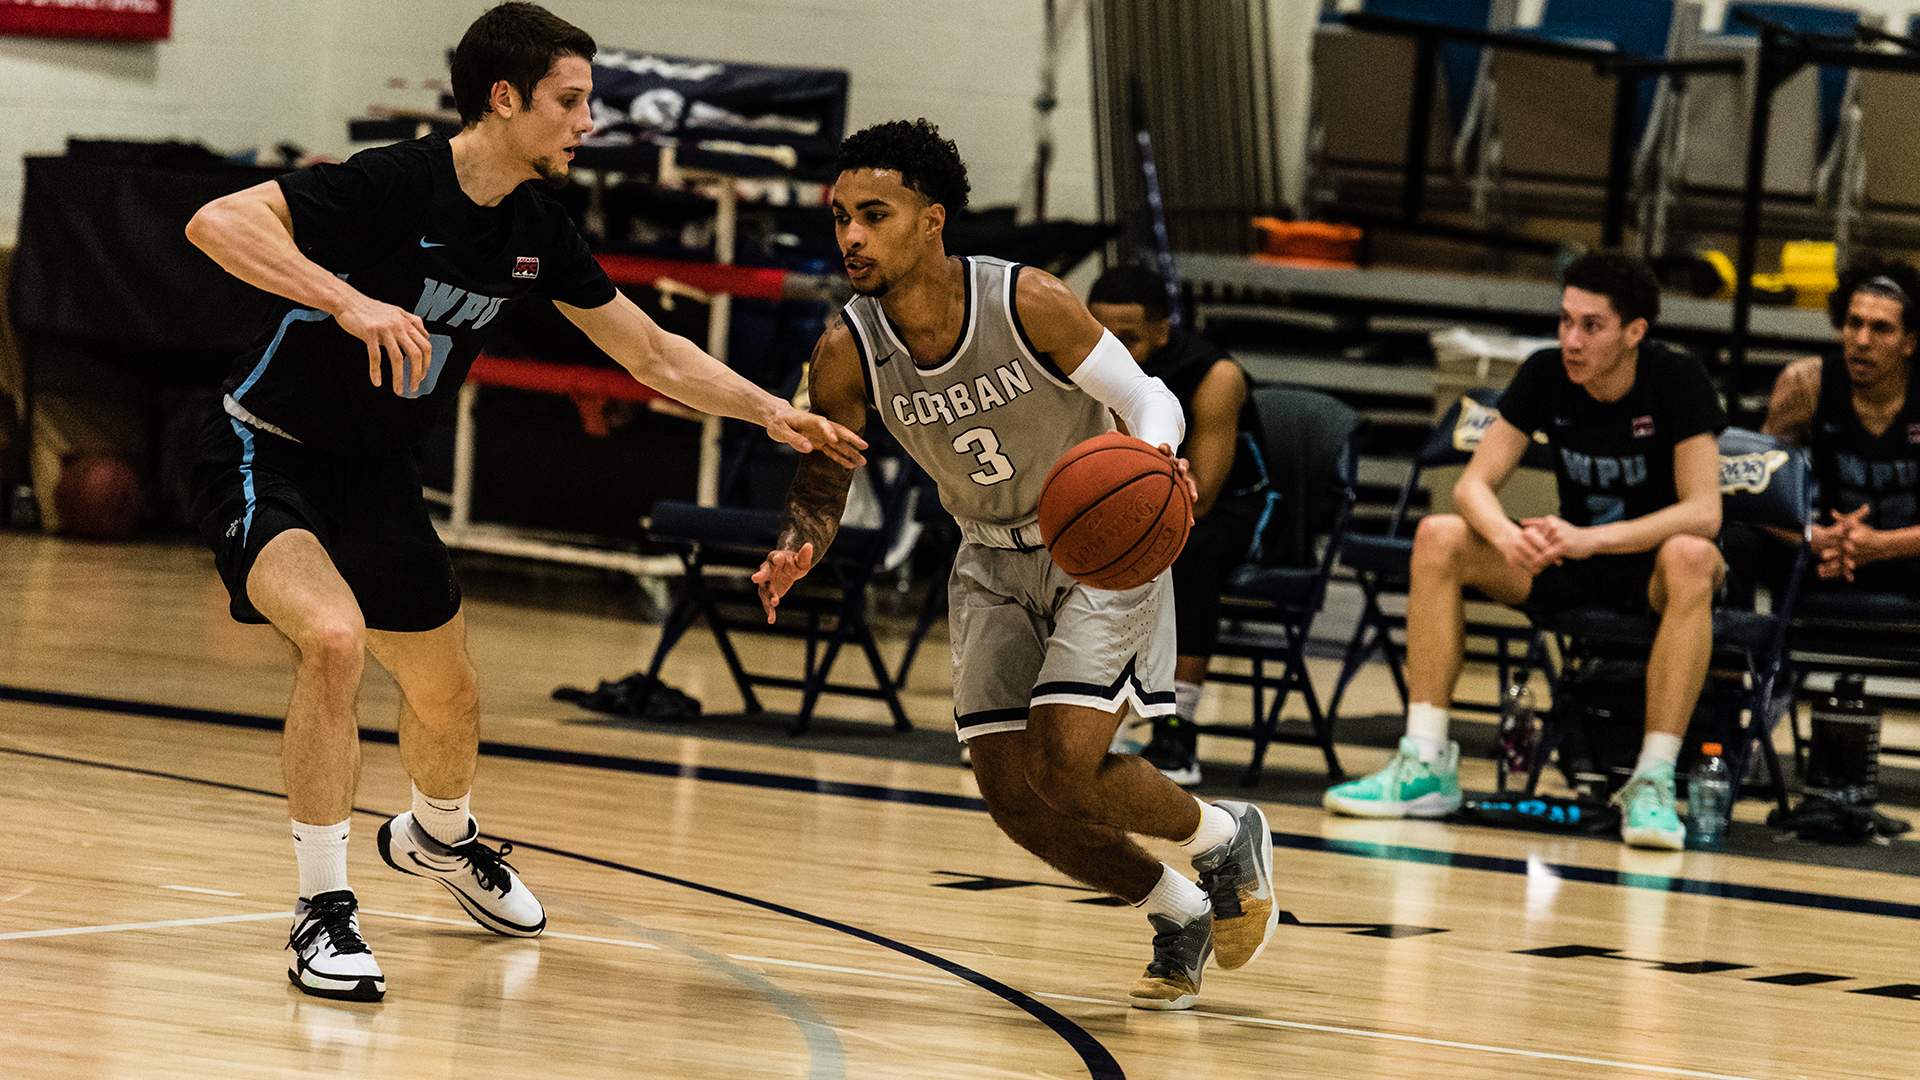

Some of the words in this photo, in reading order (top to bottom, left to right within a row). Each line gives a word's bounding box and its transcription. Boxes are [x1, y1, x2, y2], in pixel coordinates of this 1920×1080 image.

[890, 358, 1034, 426] CORBAN
[952, 426, 1017, 487] 3
[1561, 447, 1648, 488] WPU
